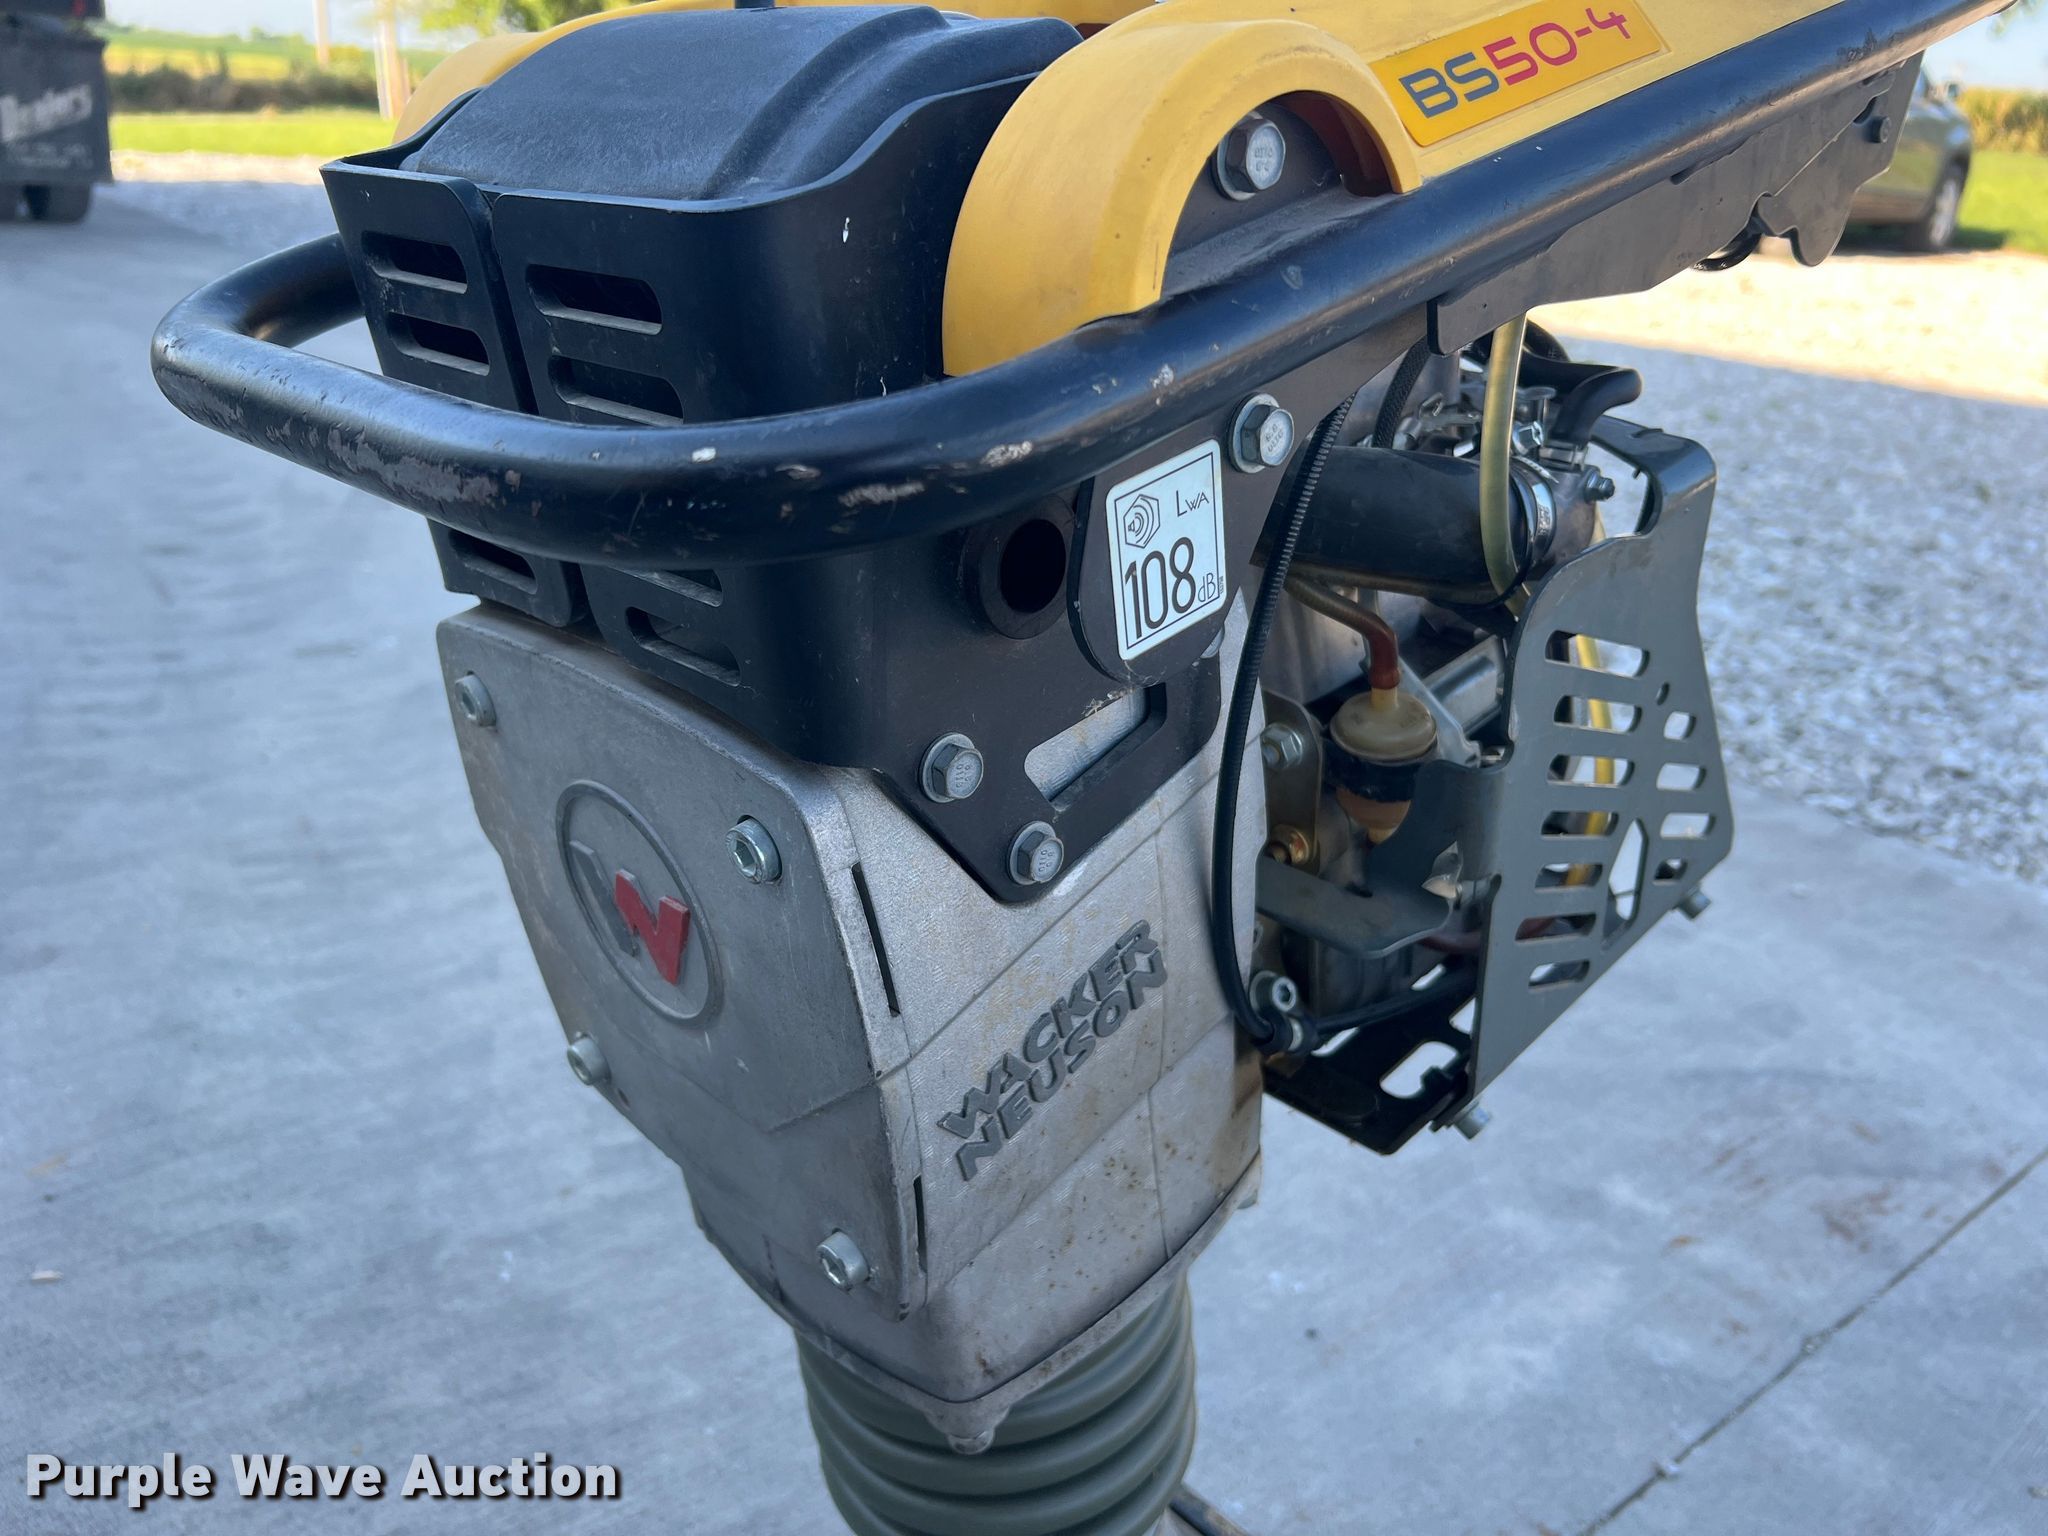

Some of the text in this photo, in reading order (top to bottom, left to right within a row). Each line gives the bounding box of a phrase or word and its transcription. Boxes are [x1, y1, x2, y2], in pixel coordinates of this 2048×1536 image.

[1398, 8, 1631, 118] BS50-4
[1124, 536, 1217, 639] 108 dB
[936, 919, 1158, 1139] WACKER
[956, 948, 1168, 1181] NEUSON
